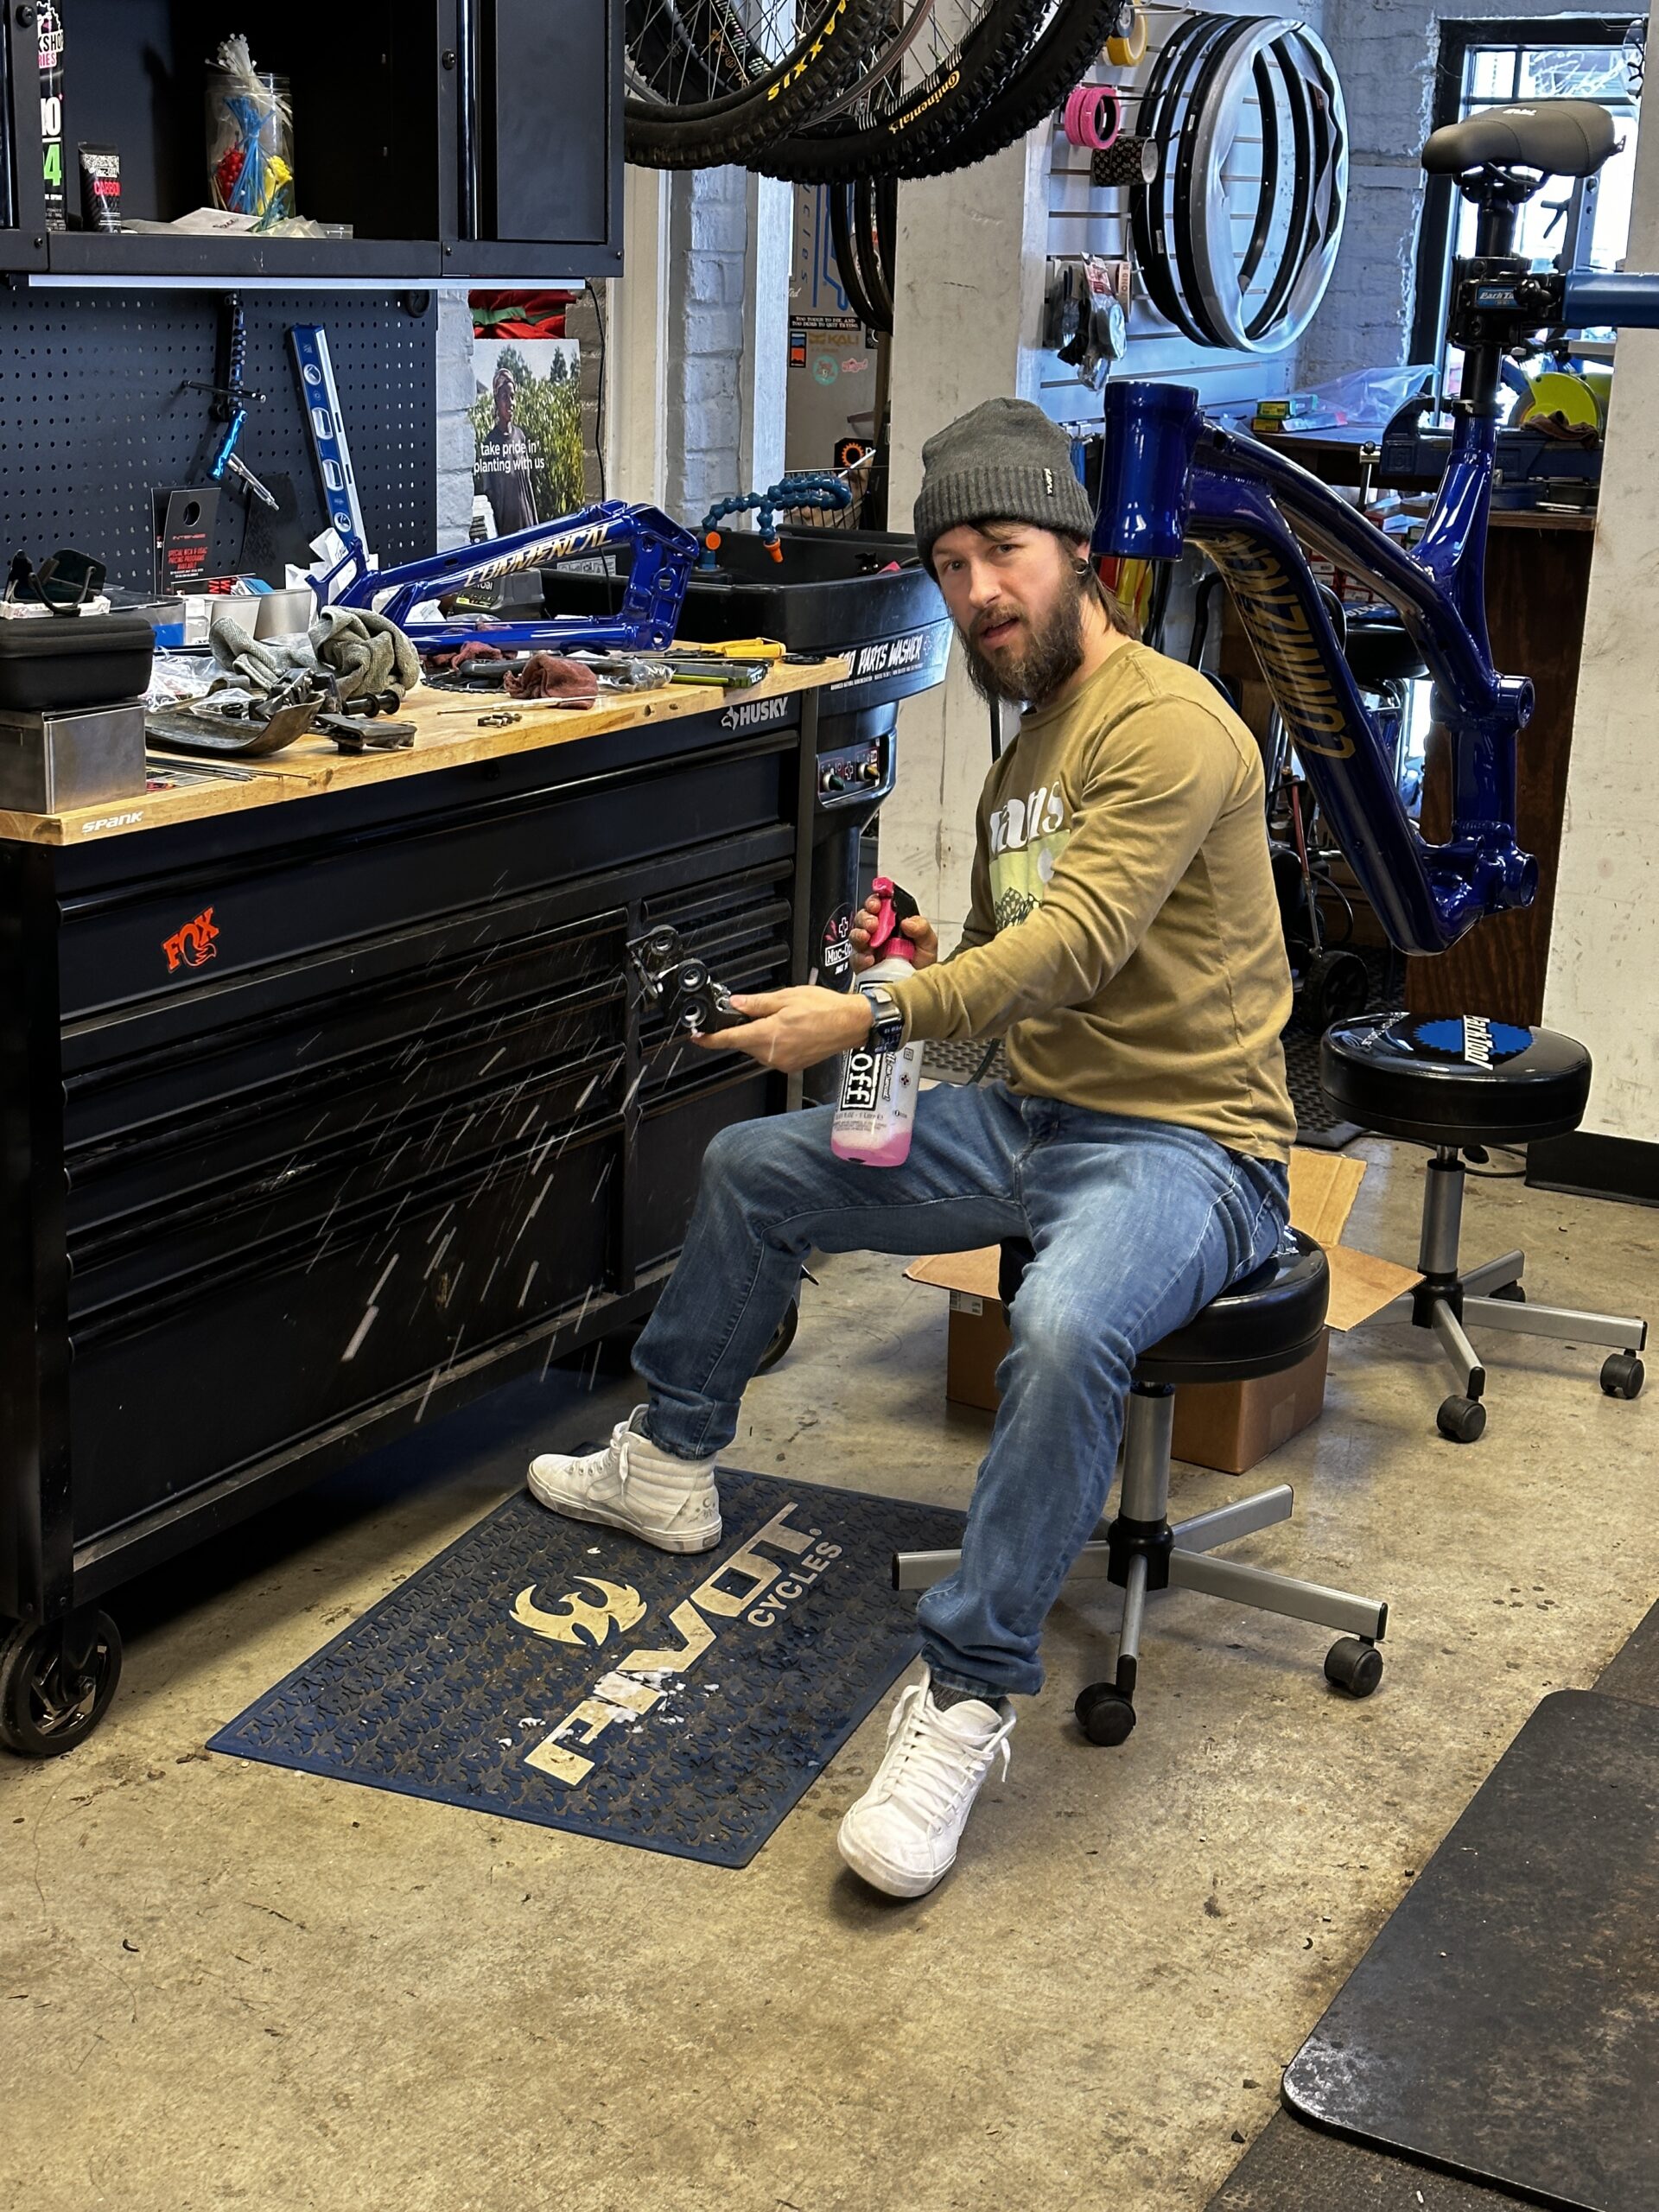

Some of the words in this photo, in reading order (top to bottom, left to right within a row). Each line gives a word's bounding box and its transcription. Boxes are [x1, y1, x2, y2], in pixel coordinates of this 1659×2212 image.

[42, 143, 62, 187] 4
[474, 458, 512, 475] planting
[513, 456, 532, 471] with
[535, 457, 544, 469] us
[480, 442, 500, 456] take
[503, 440, 526, 457] pride
[857, 643, 888, 676] PARTS
[888, 634, 924, 667] WASHER
[740, 696, 788, 726] HUSKY
[162, 906, 220, 970] FOX
[827, 942, 853, 963] Muc-O
[747, 1541, 843, 1629] CYCLES
[524, 1501, 798, 1787] PIVOT
